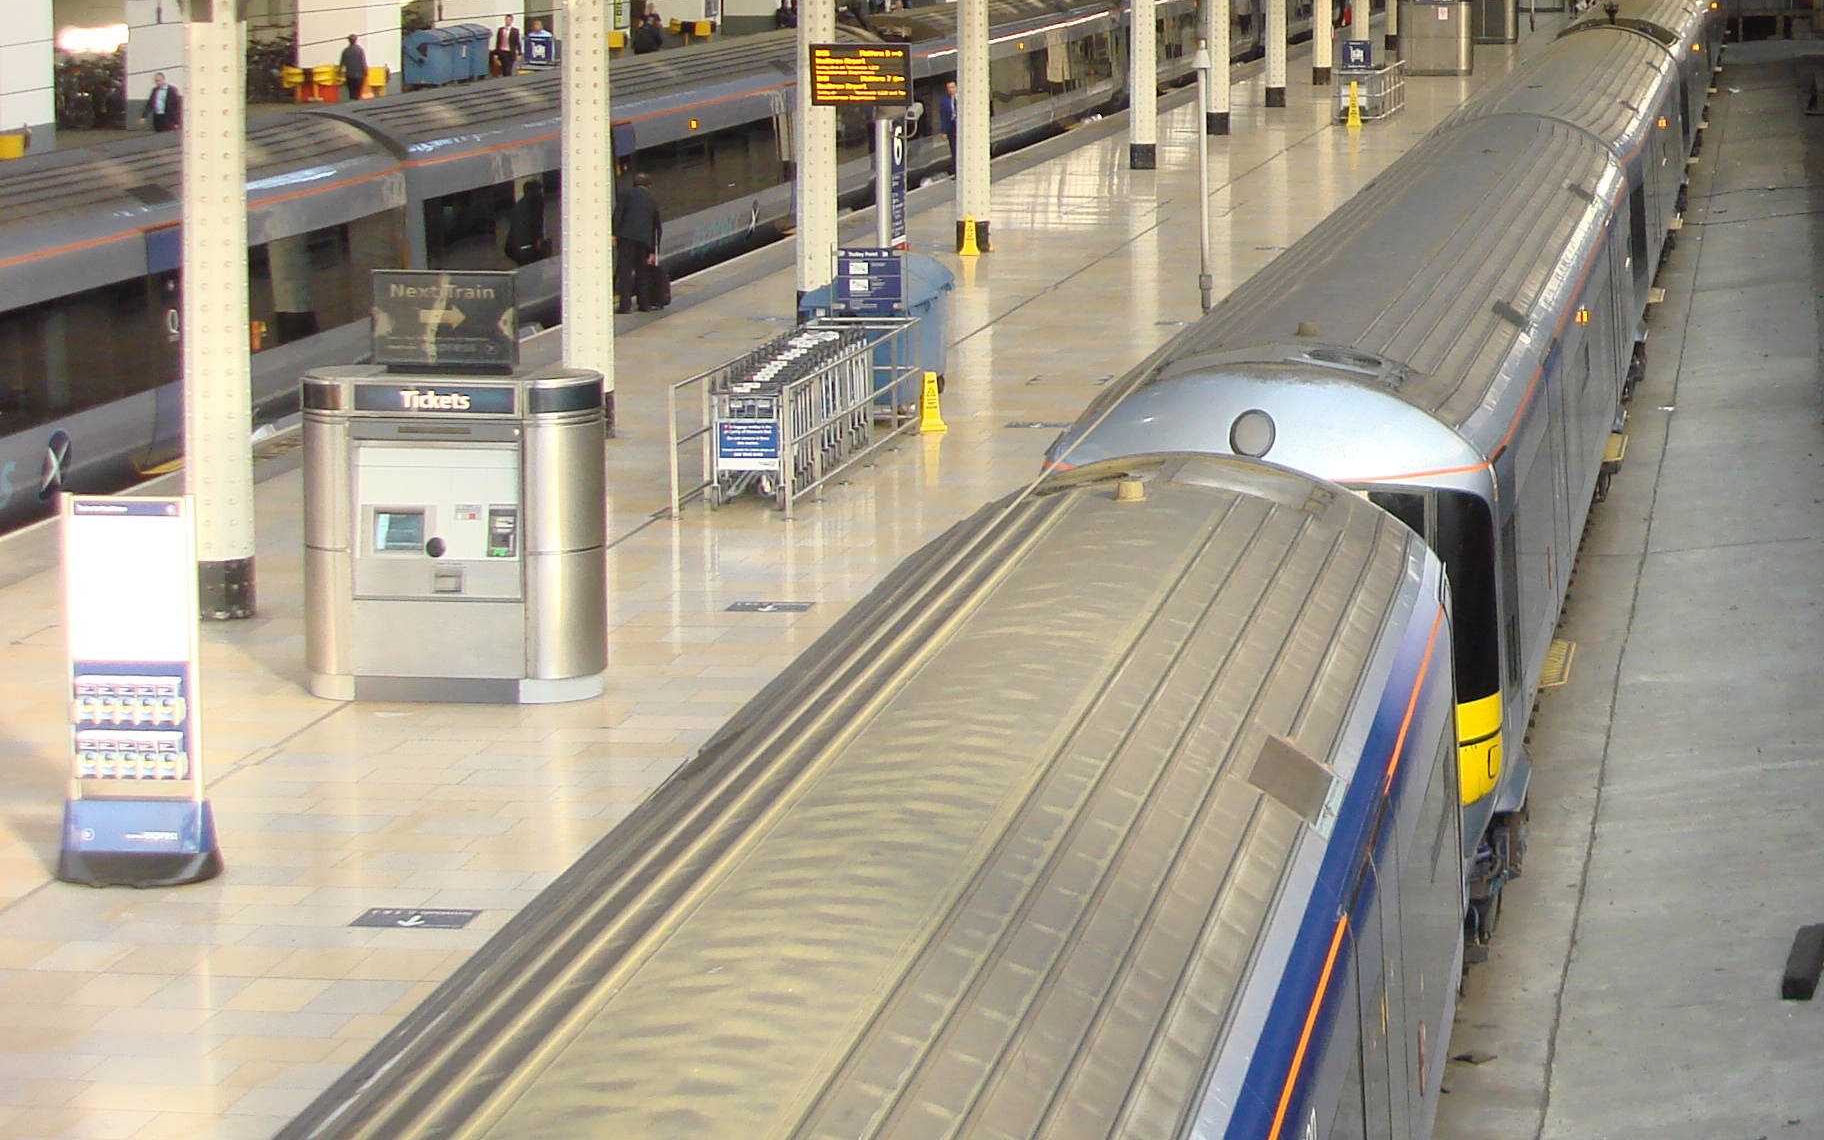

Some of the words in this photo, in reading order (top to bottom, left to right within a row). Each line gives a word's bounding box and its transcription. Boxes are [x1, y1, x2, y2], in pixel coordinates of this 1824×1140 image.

[893, 125, 903, 166] 6
[390, 283, 439, 299] Next
[444, 284, 496, 300] Train
[400, 389, 471, 410] Tickets
